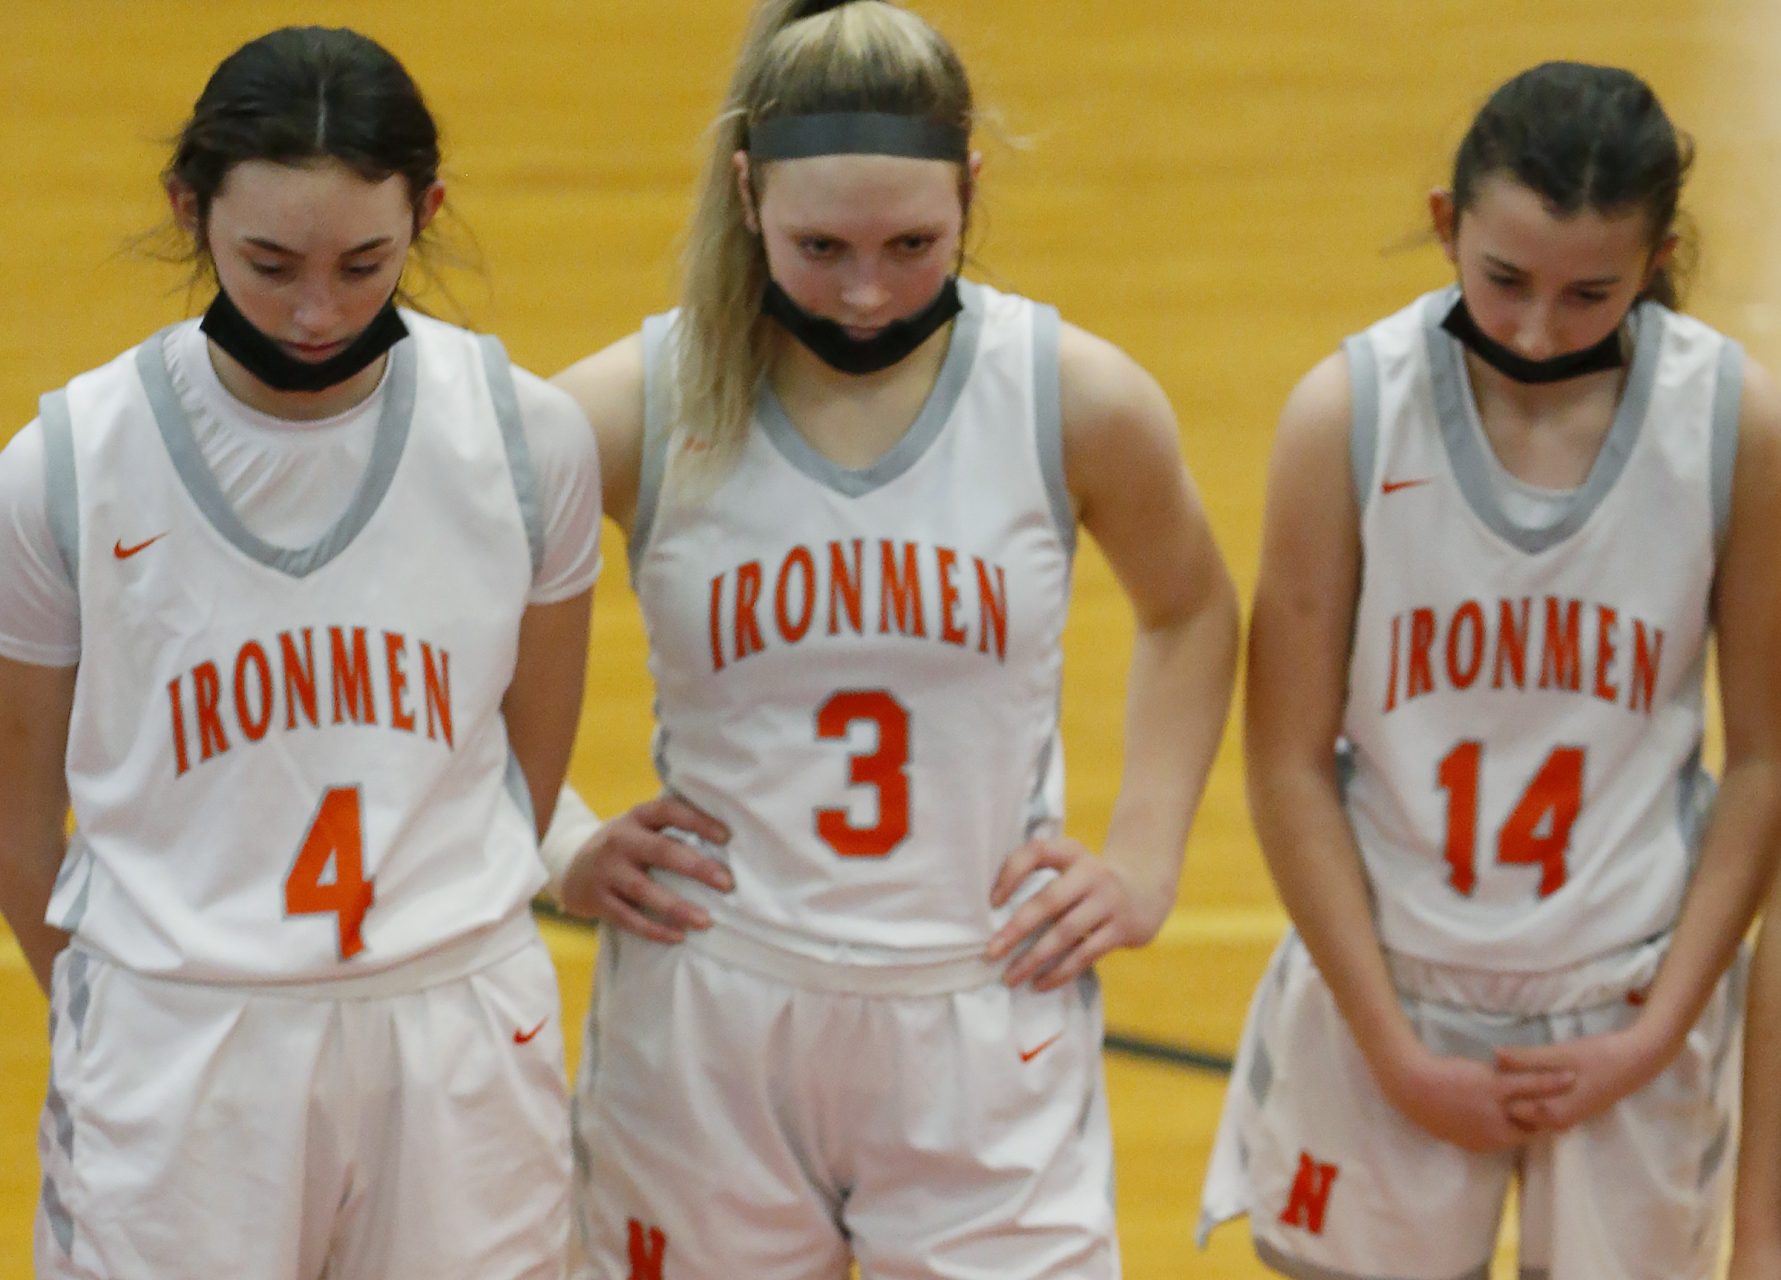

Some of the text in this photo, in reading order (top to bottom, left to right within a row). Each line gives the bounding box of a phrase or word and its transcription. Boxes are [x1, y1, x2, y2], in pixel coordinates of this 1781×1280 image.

[709, 537, 1008, 672] IRONMEN
[1384, 595, 1664, 714] IRONMEN
[167, 625, 454, 777] IRONMEN
[813, 688, 911, 858] 3
[283, 783, 375, 961] 4
[1437, 741, 1588, 898] 14
[1278, 1150, 1339, 1235] N
